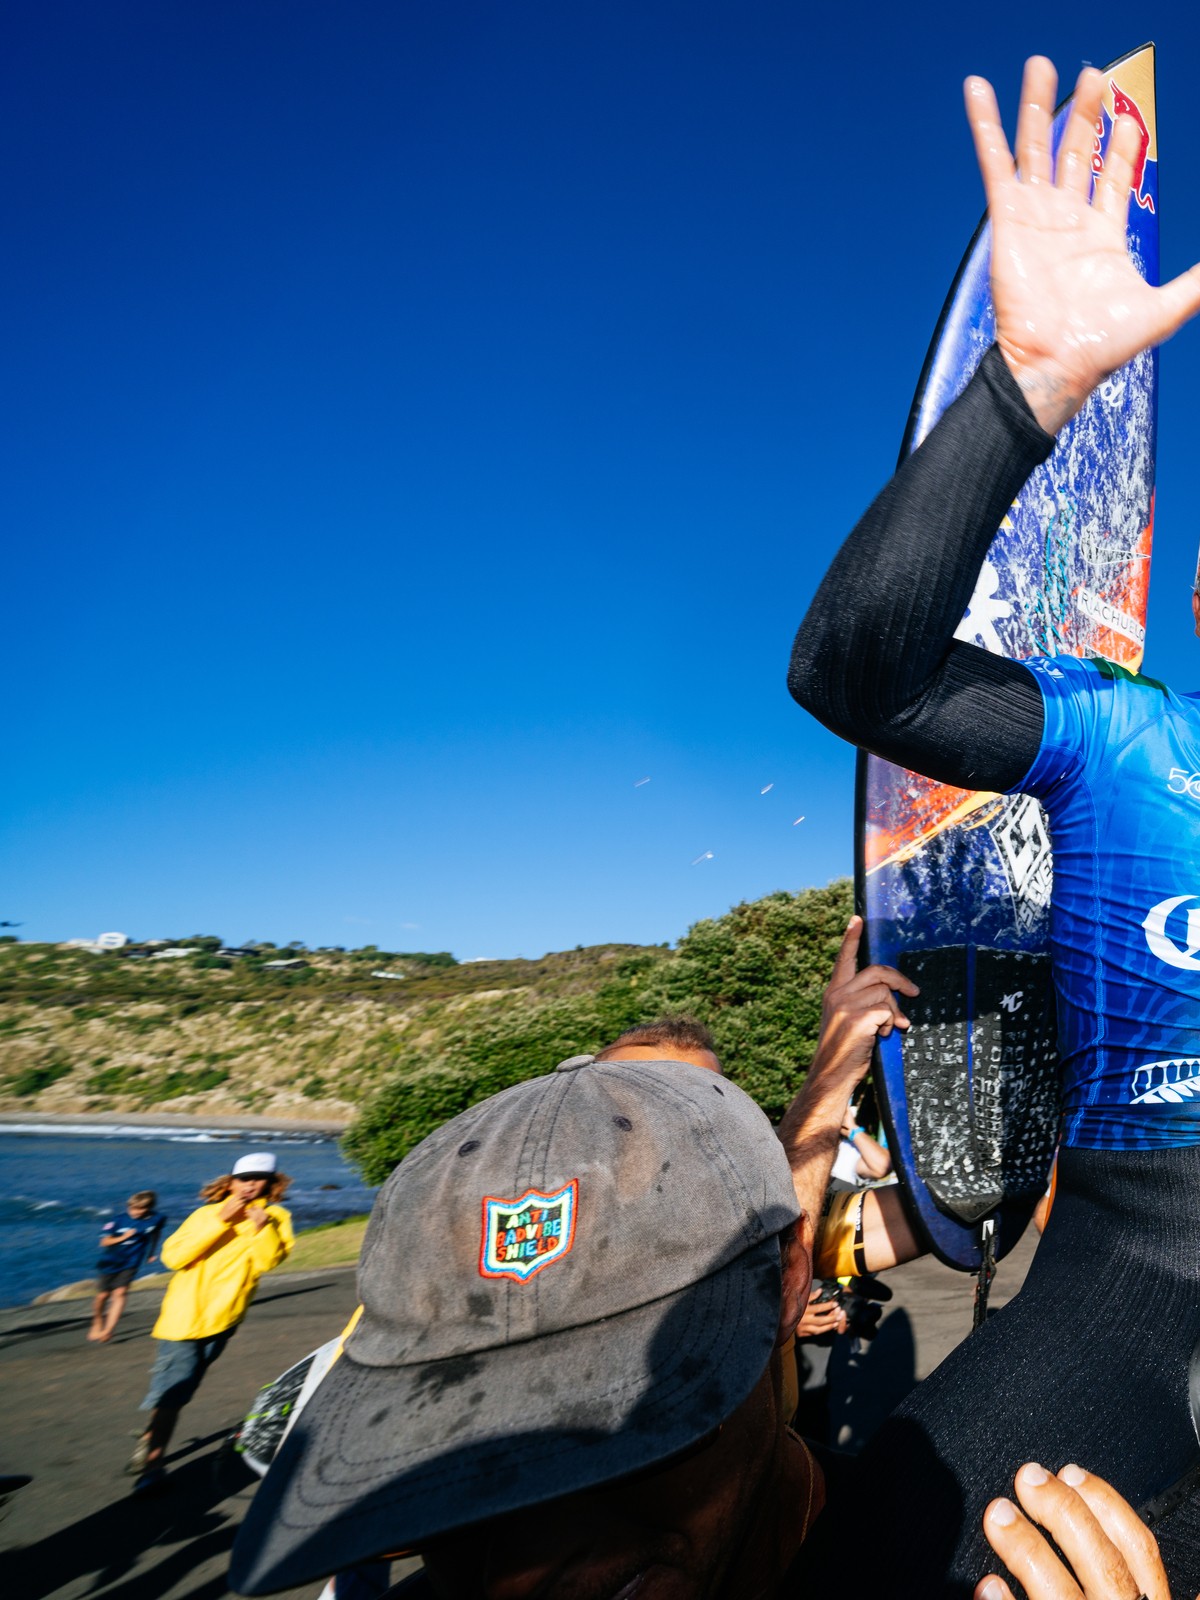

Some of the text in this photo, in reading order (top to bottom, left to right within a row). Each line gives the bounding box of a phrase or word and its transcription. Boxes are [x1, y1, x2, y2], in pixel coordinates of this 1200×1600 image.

[1081, 591, 1145, 642] RIACHUELO
[505, 1208, 549, 1229] ANTI
[496, 1236, 558, 1261] SHIELD
